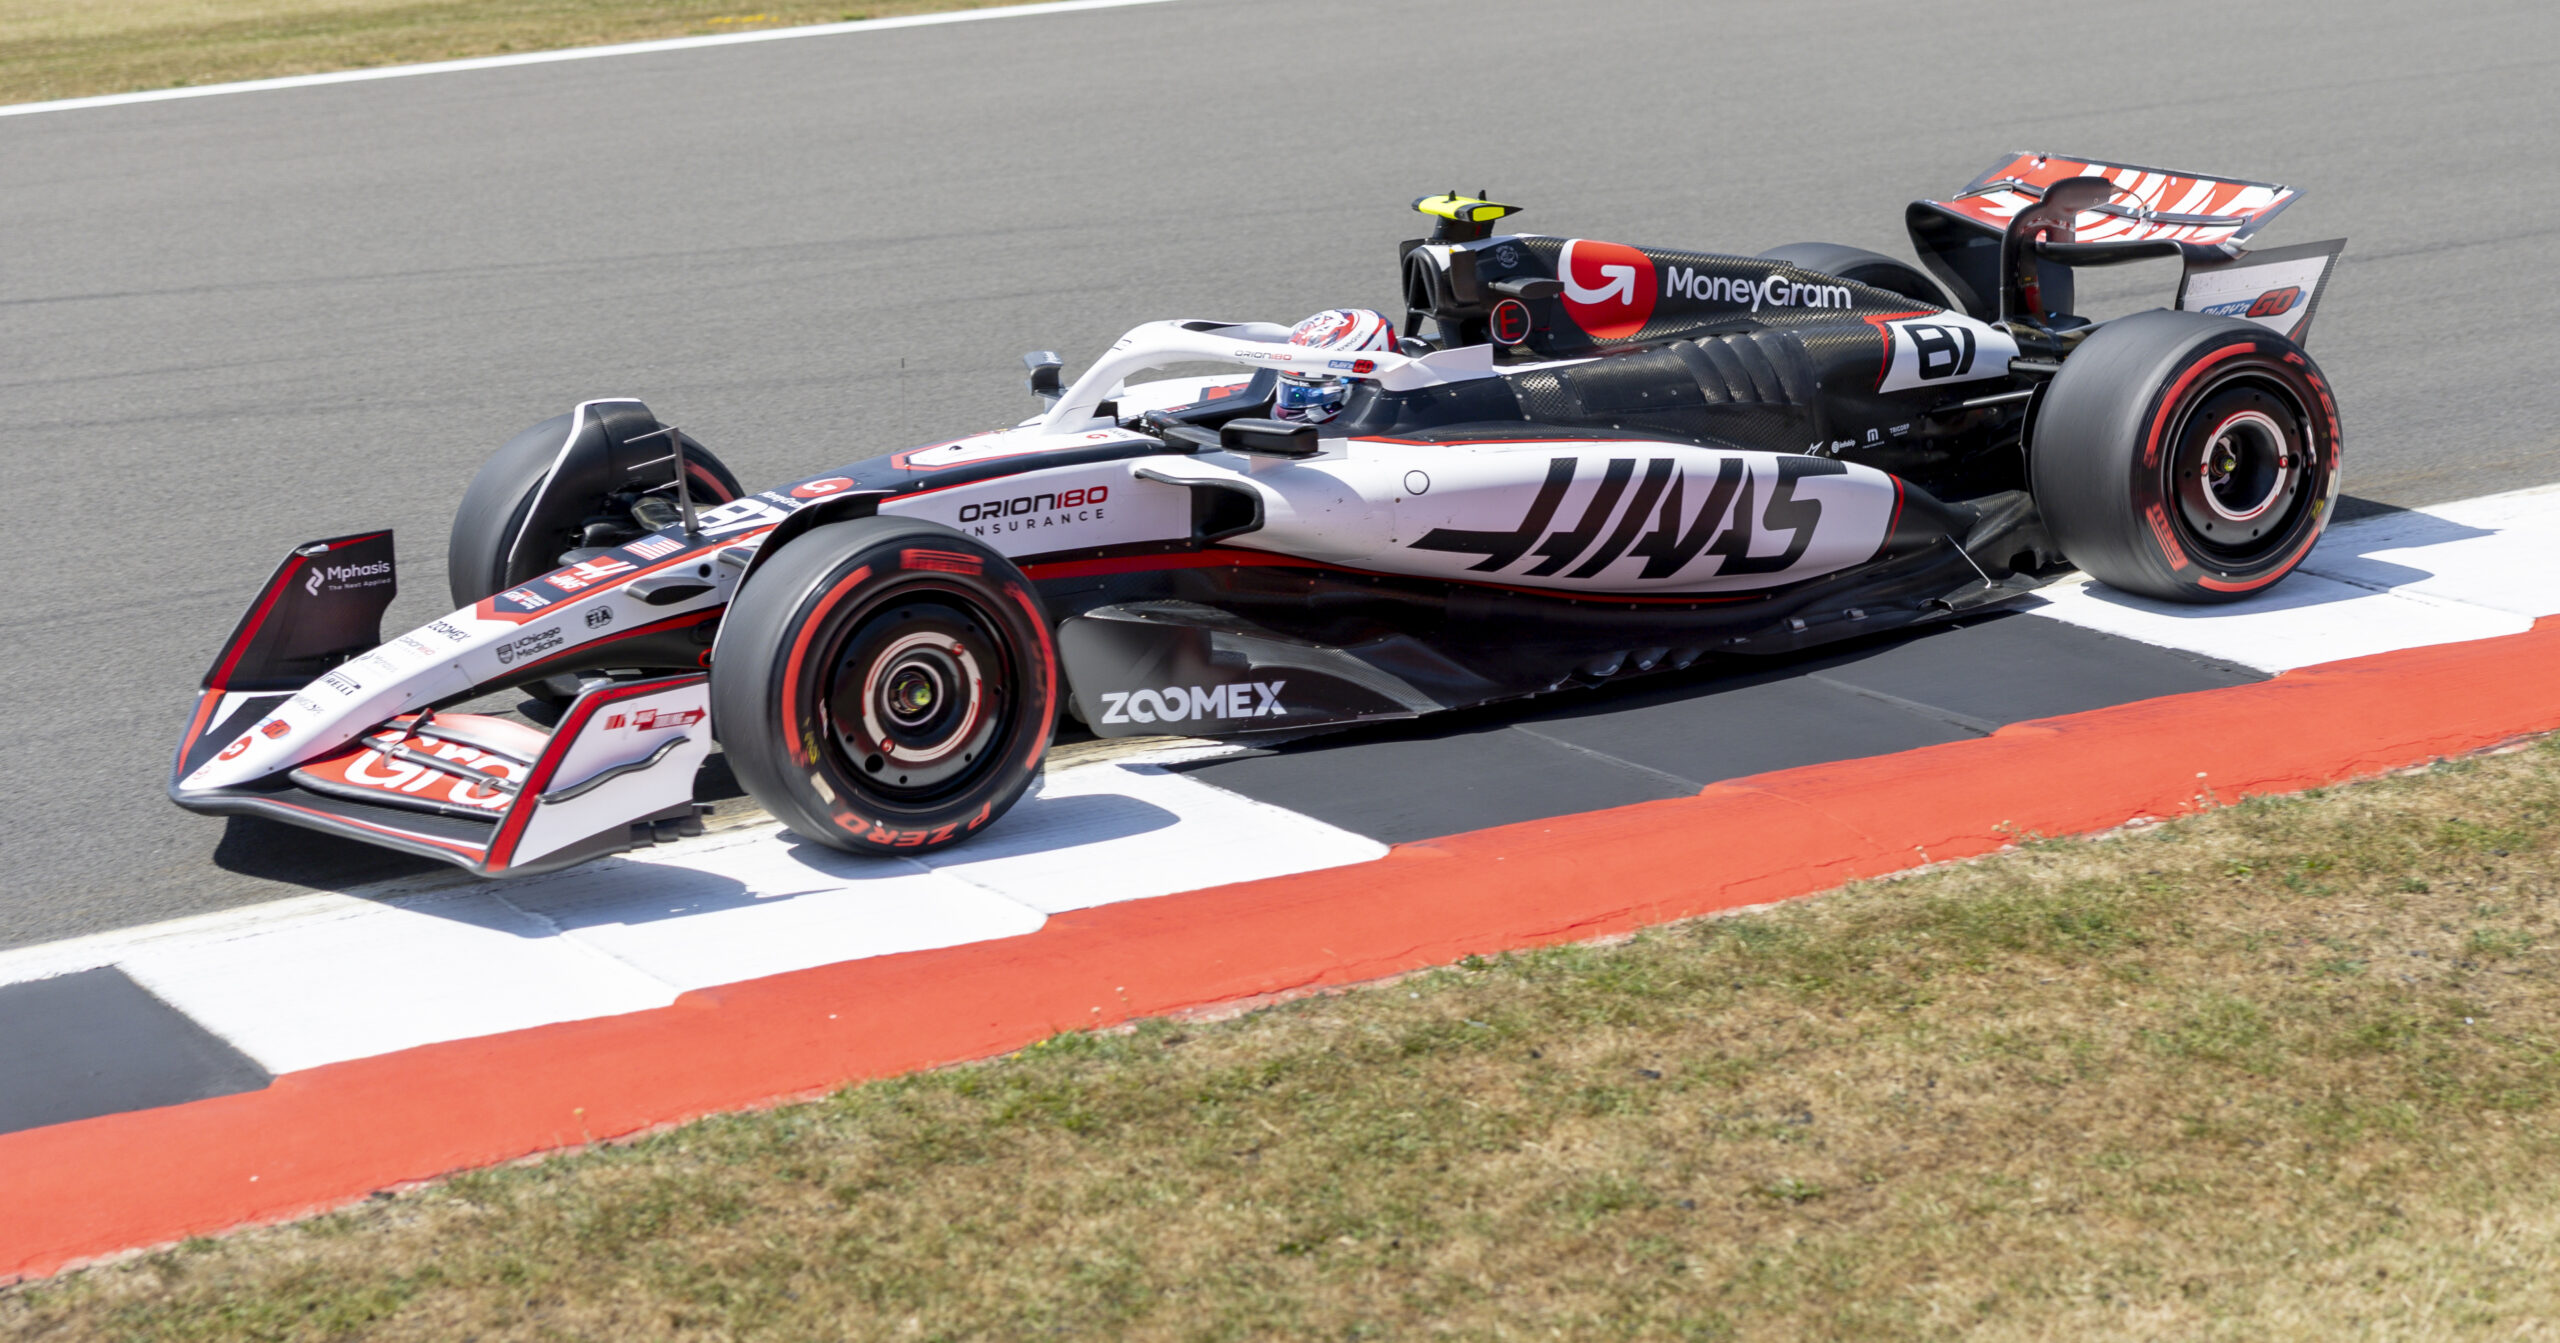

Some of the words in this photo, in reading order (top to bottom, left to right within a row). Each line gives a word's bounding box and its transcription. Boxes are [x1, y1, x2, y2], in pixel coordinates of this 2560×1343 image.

[1666, 265, 1853, 313] MoneyGram
[2246, 286, 2300, 318] GO
[1500, 304, 1522, 339] E
[2282, 351, 2307, 367] P
[2304, 371, 2341, 470] ZERO
[959, 485, 1108, 523] ORION180
[1406, 457, 1848, 579] HAAS
[327, 560, 391, 582] Mphasis
[513, 626, 561, 649] UChicago
[516, 636, 564, 659] Medicine
[1102, 680, 1288, 724] ZOOMEX
[831, 811, 959, 847] ZERO
[967, 800, 991, 831] P
